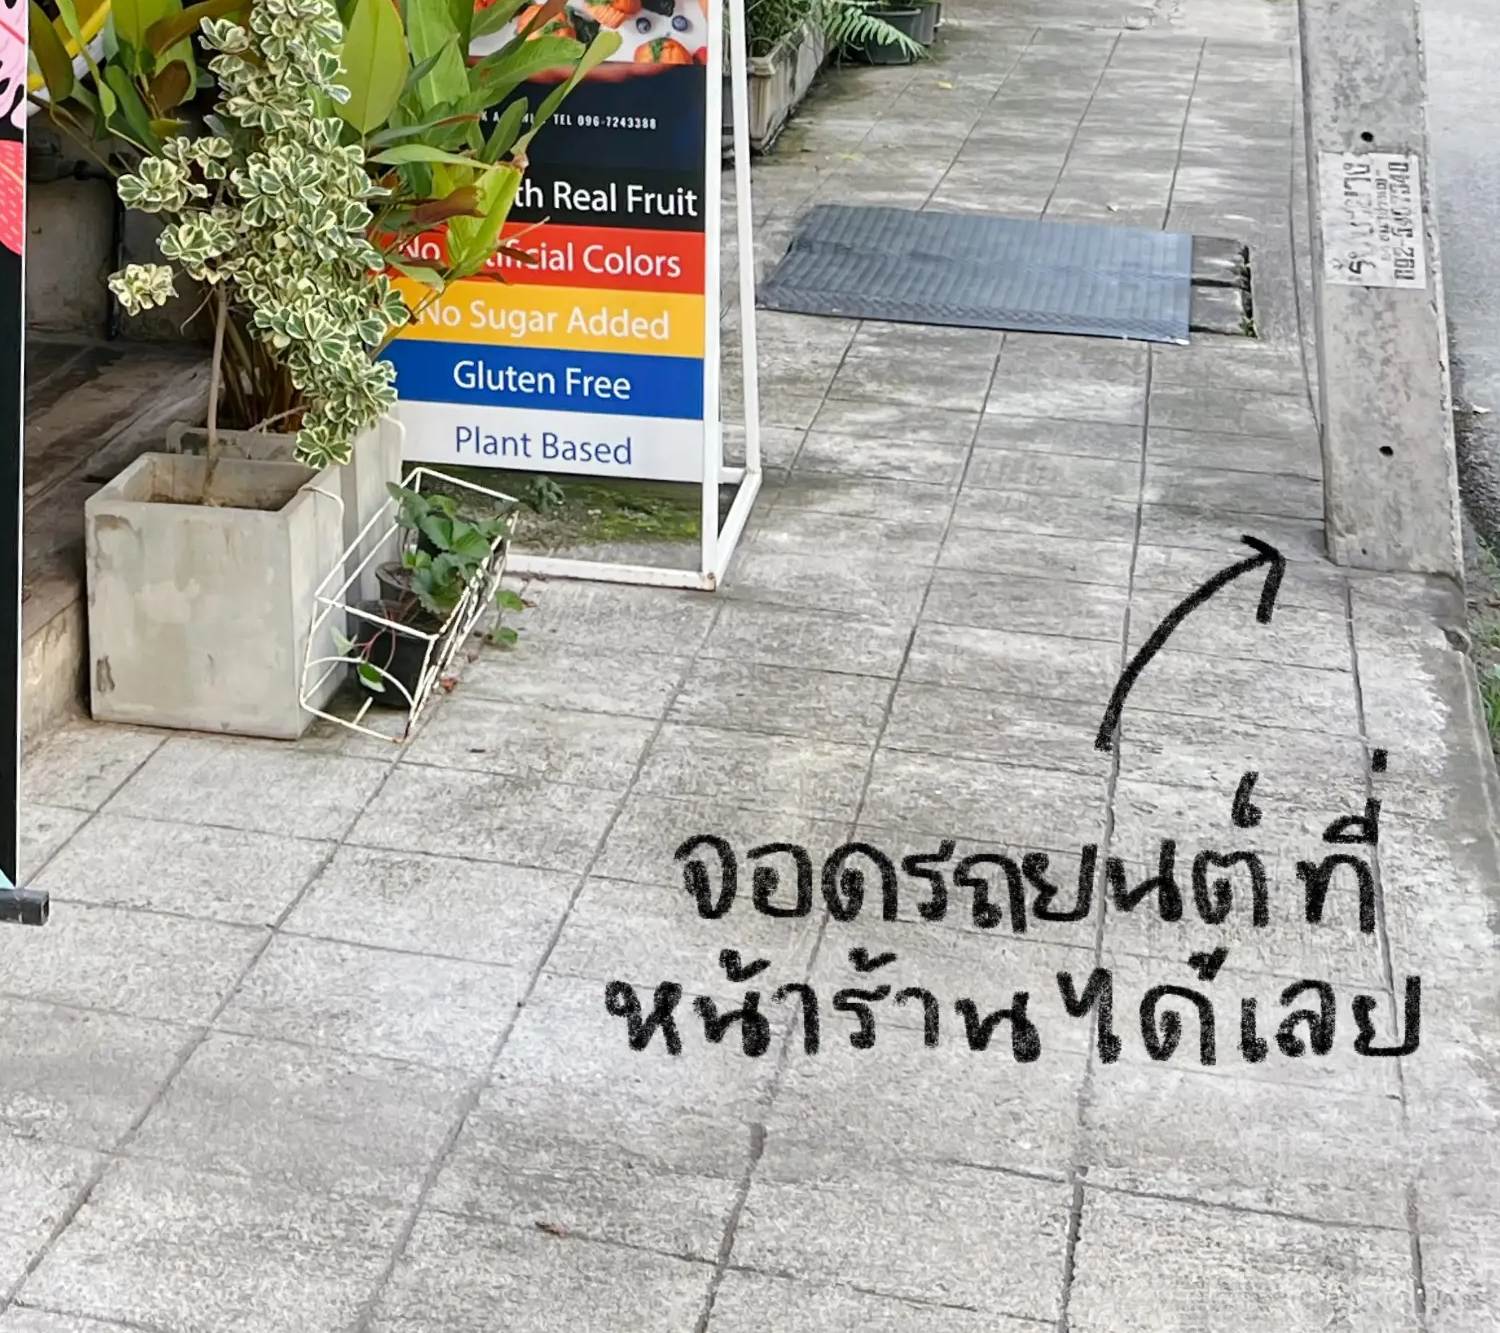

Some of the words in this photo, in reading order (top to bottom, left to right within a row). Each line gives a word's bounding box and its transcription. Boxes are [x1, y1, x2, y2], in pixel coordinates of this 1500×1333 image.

[554, 113, 572, 125] TEL
[553, 181, 617, 213] Real
[627, 183, 698, 217] Fruit
[399, 235, 441, 261] No
[583, 244, 682, 278] Colors
[418, 299, 461, 327] No
[470, 301, 558, 338] Sugar
[567, 305, 670, 340] Added
[453, 360, 556, 395] Gluten
[565, 368, 631, 400] Free
[455, 426, 532, 458] Plant
[542, 431, 632, 465] Based
